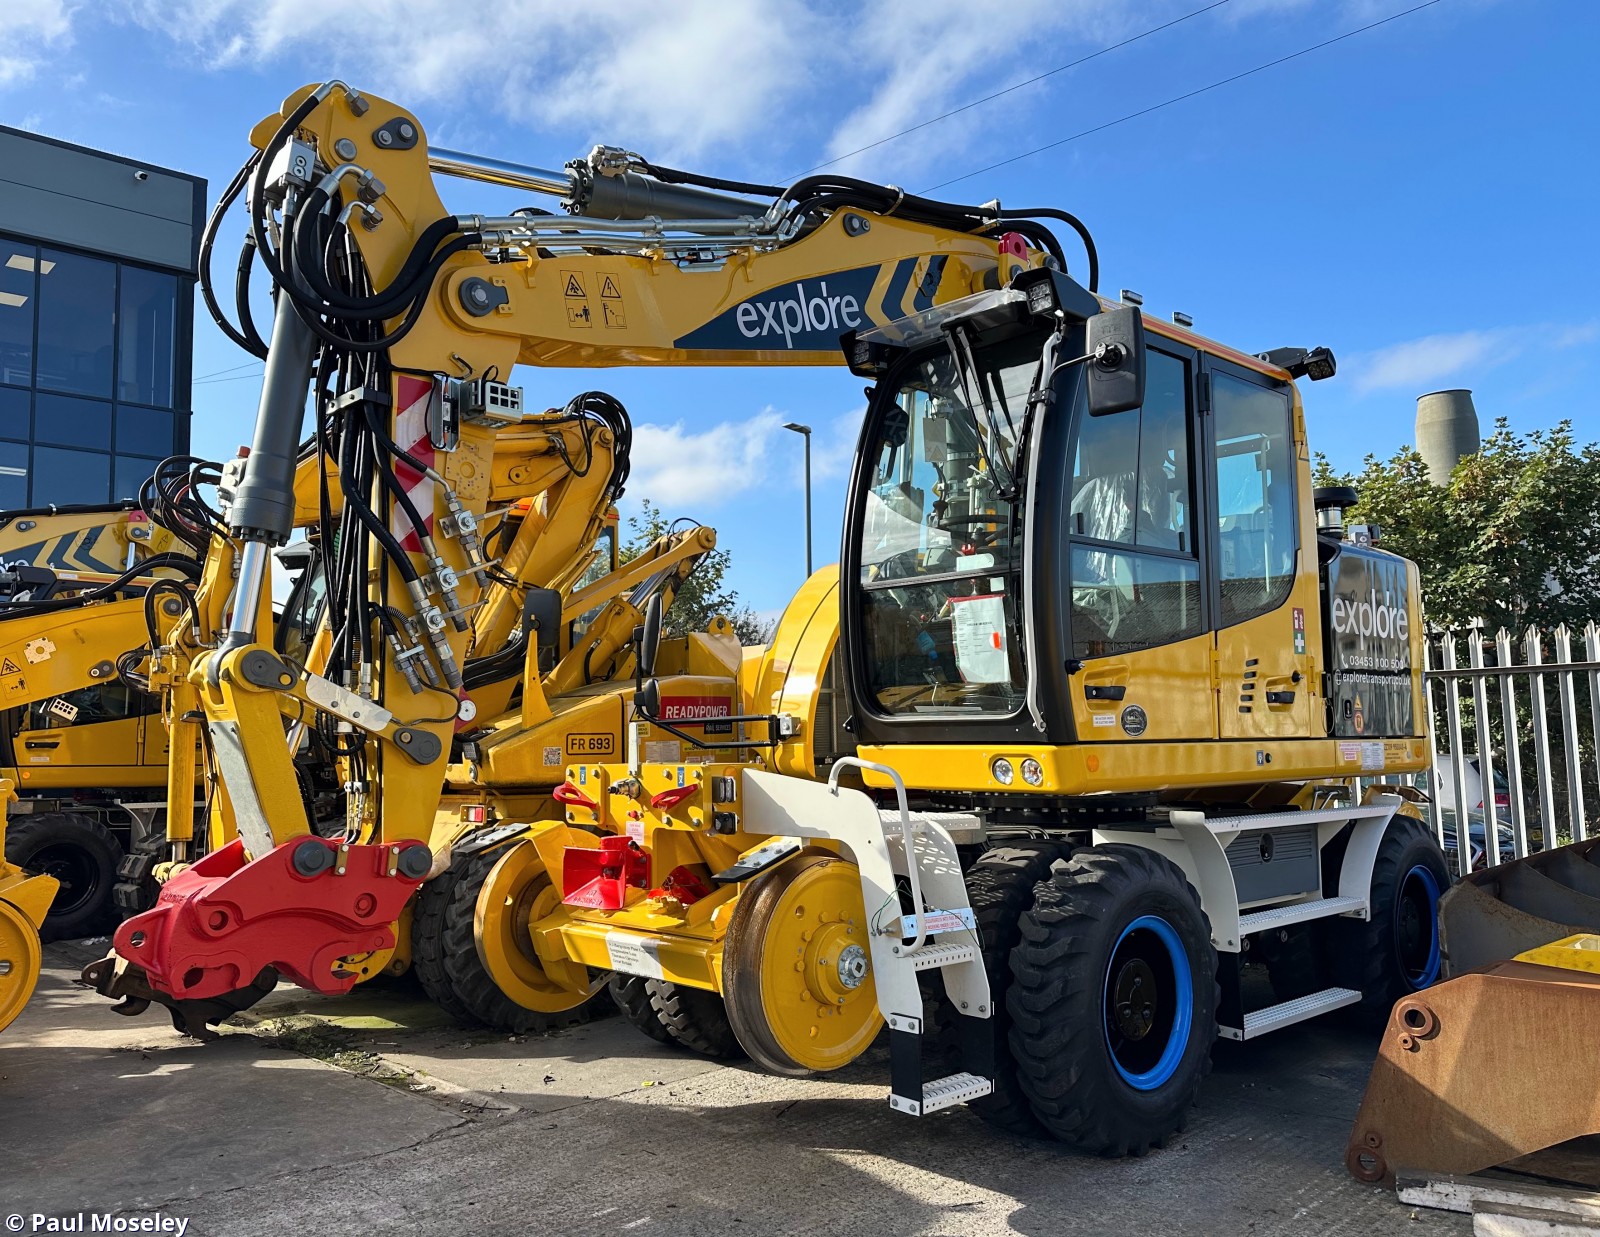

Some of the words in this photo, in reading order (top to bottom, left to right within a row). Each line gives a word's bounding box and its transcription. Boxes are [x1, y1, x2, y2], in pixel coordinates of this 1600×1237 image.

[1349, 655, 1374, 667] 03453
[665, 705, 728, 719] READYPOWER
[571, 738, 586, 750] FR
[588, 737, 611, 750] 693
